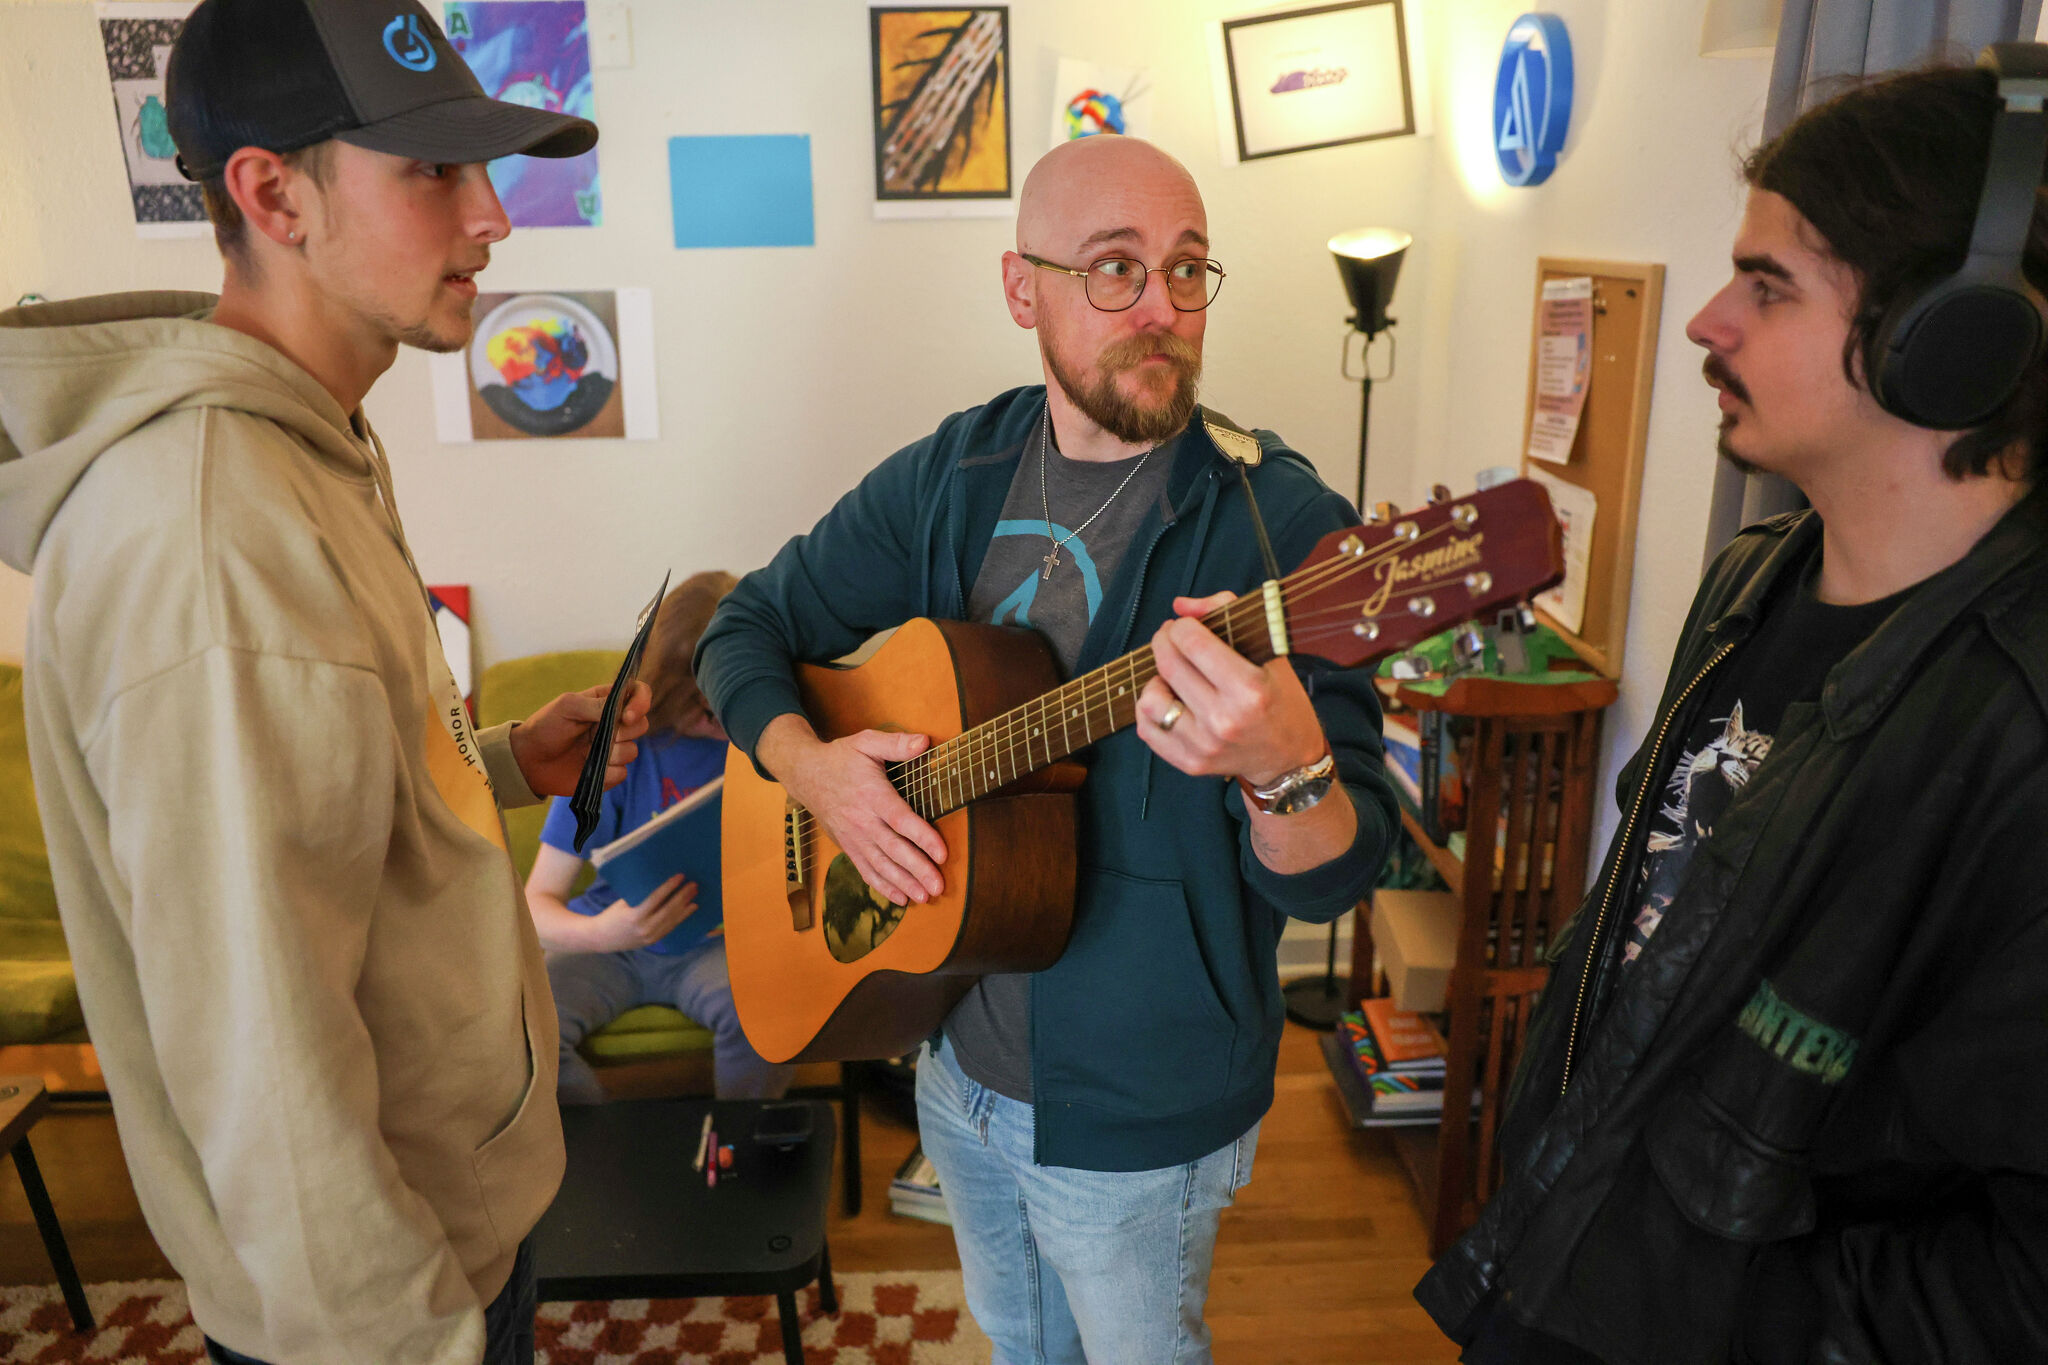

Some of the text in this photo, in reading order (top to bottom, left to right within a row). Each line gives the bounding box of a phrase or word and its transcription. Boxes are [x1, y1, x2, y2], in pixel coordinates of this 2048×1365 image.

[451, 12, 469, 35] A
[1364, 532, 1483, 617] Jasmine
[451, 707, 475, 767] HONOR
